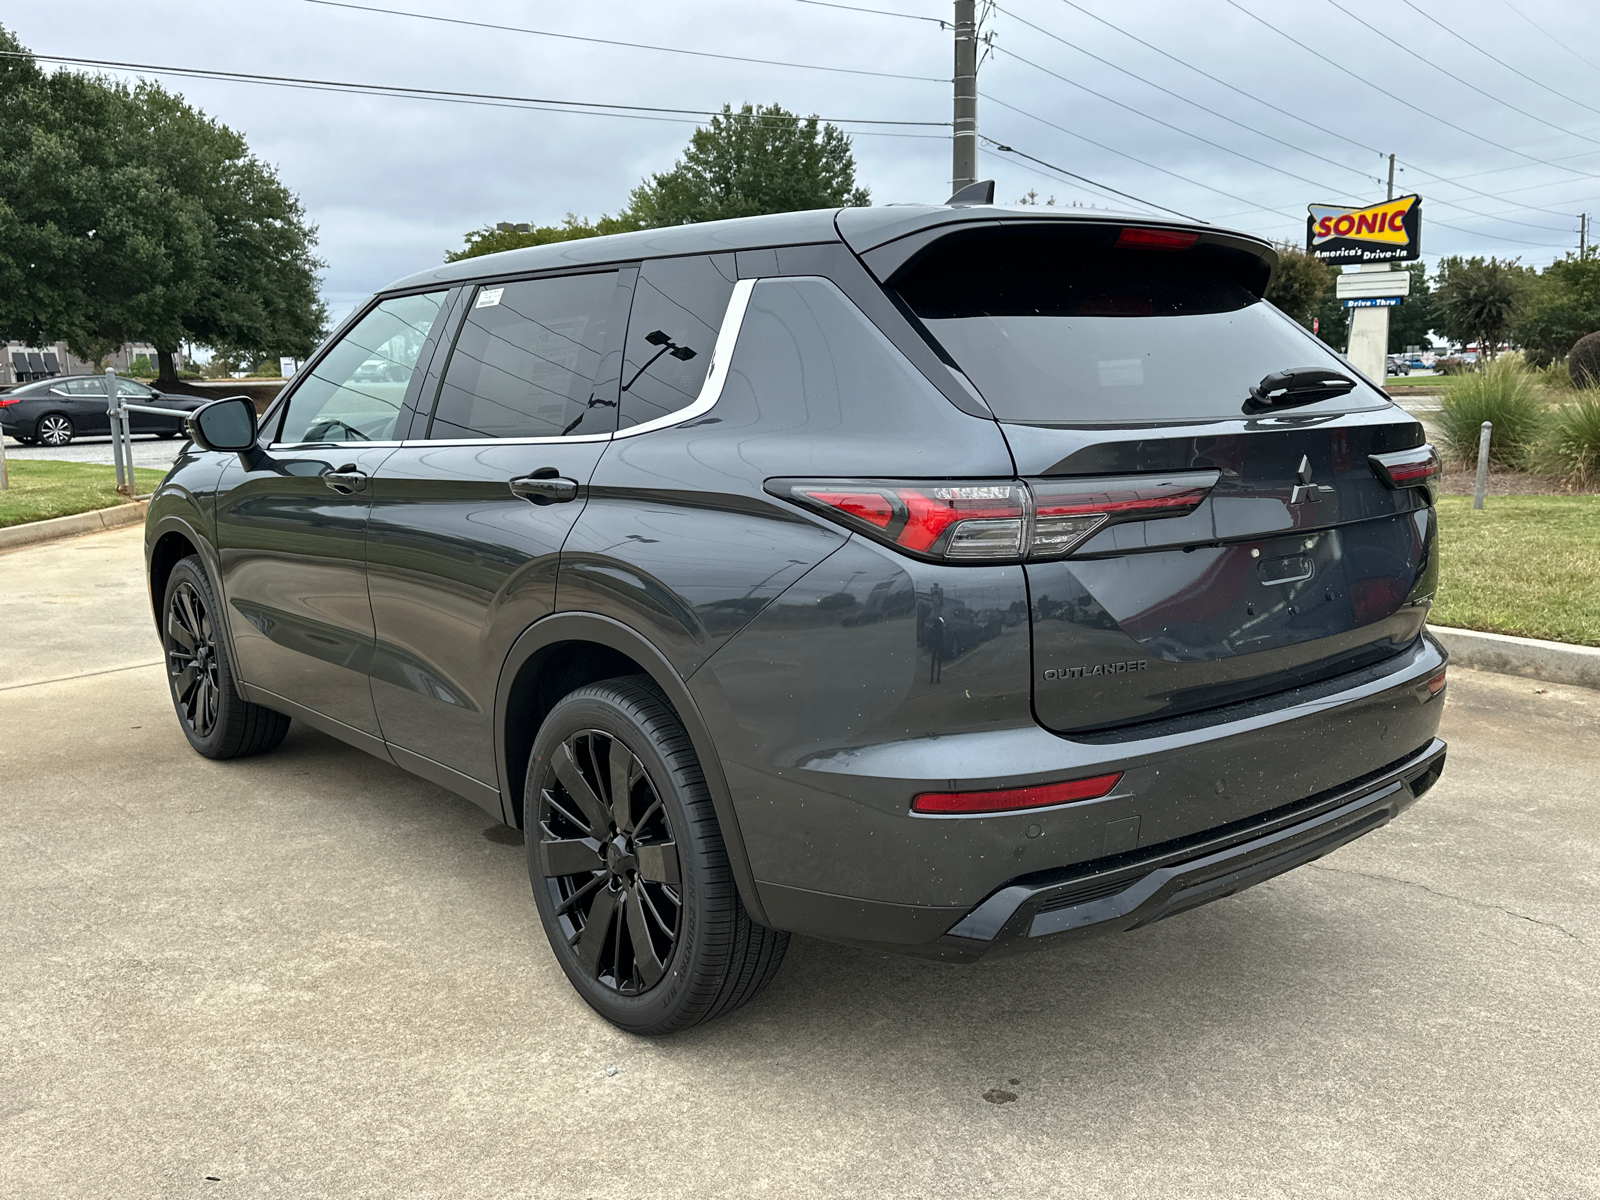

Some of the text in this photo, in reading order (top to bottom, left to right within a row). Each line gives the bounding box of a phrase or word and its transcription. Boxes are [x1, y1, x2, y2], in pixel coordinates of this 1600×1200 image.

[1316, 210, 1406, 238] SONIC
[1314, 247, 1362, 259] America's
[1043, 660, 1148, 681] OUTLANDER
